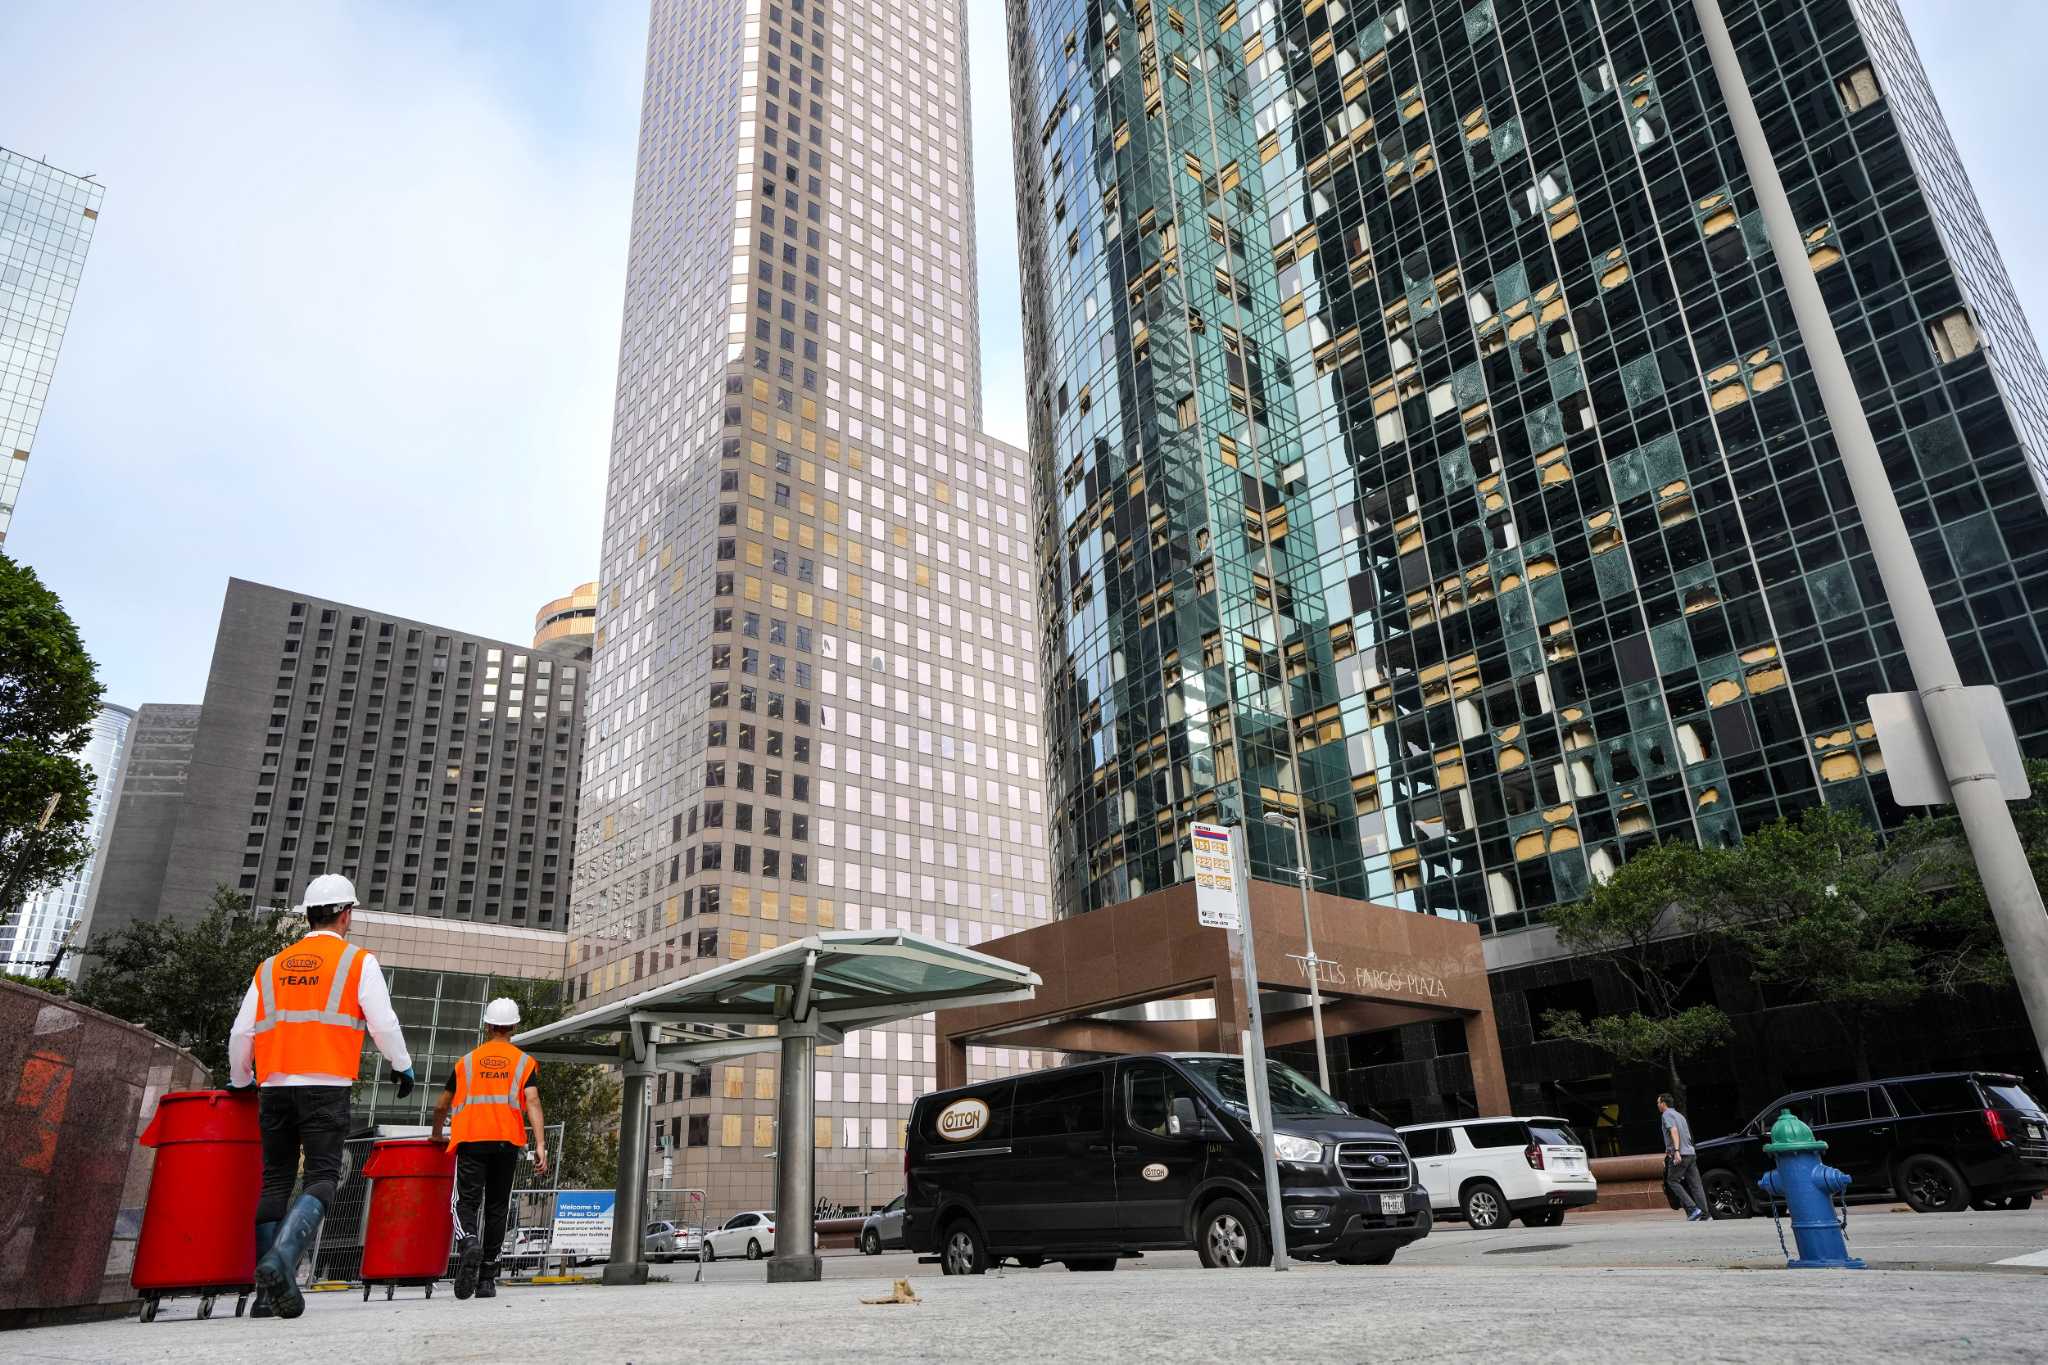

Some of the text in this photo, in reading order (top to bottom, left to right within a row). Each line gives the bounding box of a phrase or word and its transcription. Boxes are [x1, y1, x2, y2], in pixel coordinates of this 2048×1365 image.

[279, 976, 319, 986] TEAM
[1296, 959, 1447, 999] WLLS FARGO PLAZA
[480, 1071, 509, 1079] TEAM
[943, 1109, 981, 1132] COTTON
[1145, 1167, 1165, 1178] COTTON
